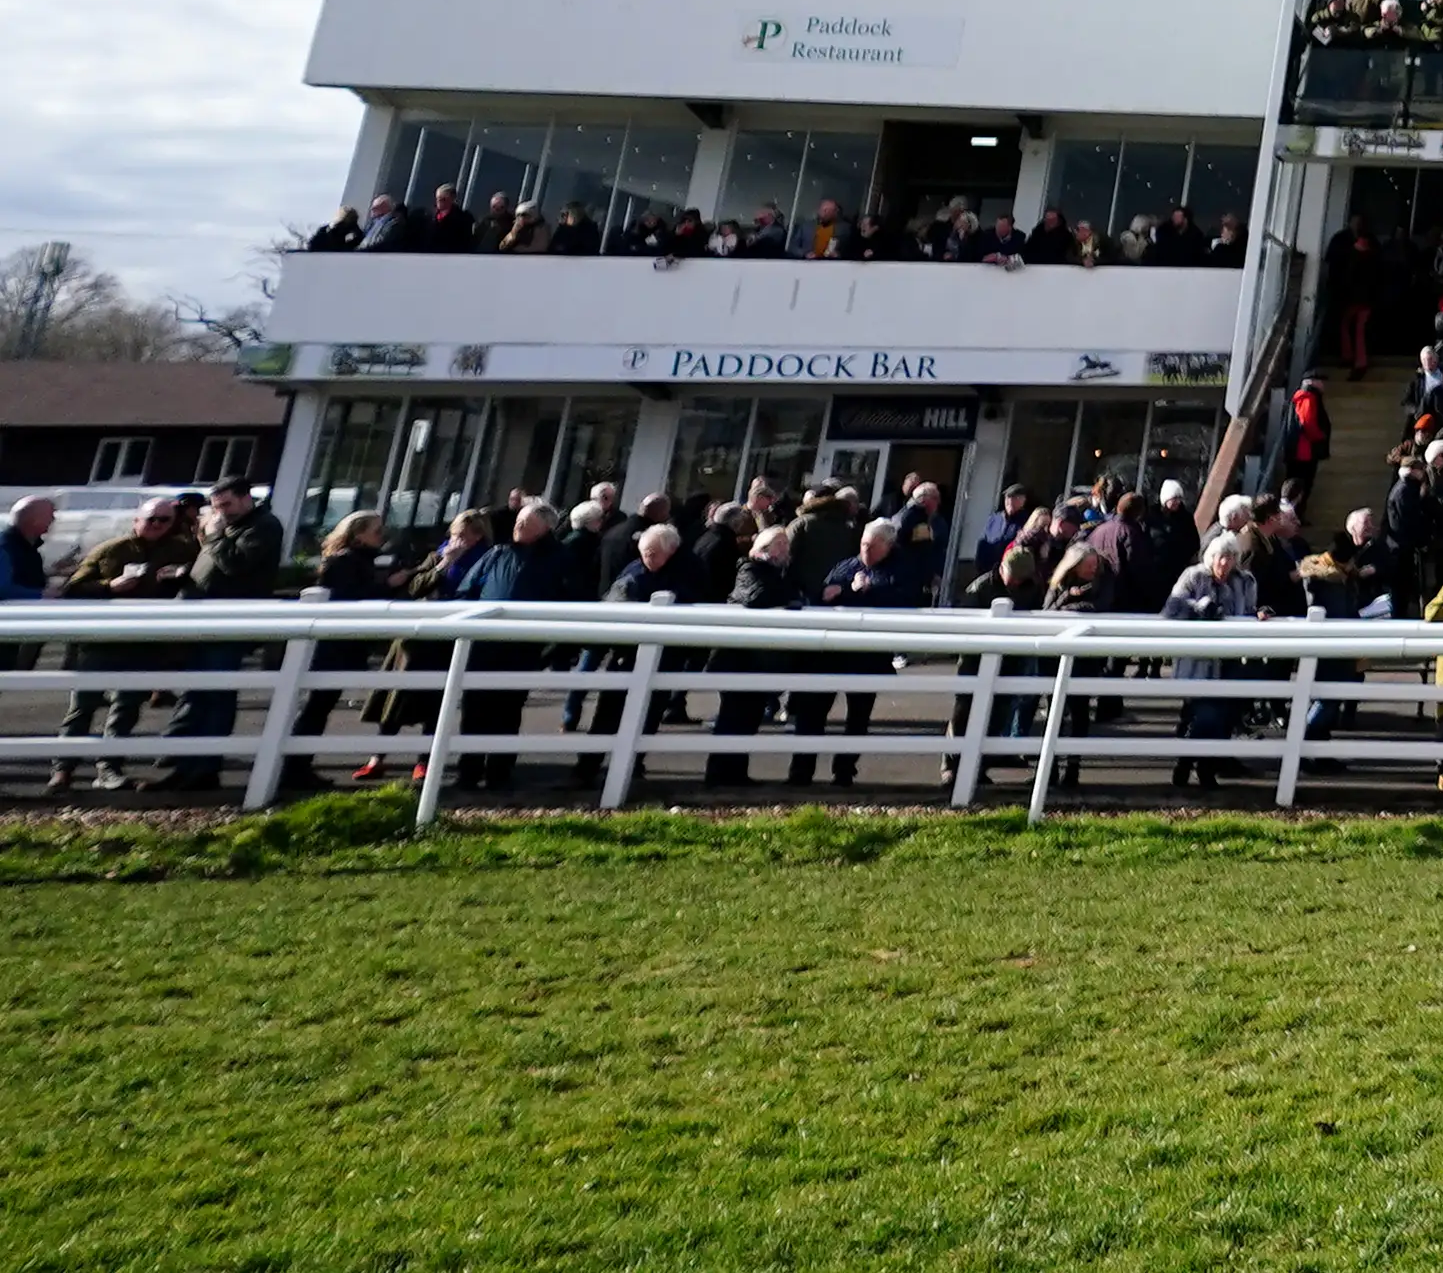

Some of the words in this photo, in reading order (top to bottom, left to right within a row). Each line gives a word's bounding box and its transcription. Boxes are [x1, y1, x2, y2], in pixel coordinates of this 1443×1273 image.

[755, 19, 782, 50] P
[806, 16, 892, 37] Paddock
[791, 41, 904, 62] Restaurant
[670, 349, 854, 378] PADDOCK
[870, 351, 938, 379] BAR
[923, 407, 968, 429] HILL
